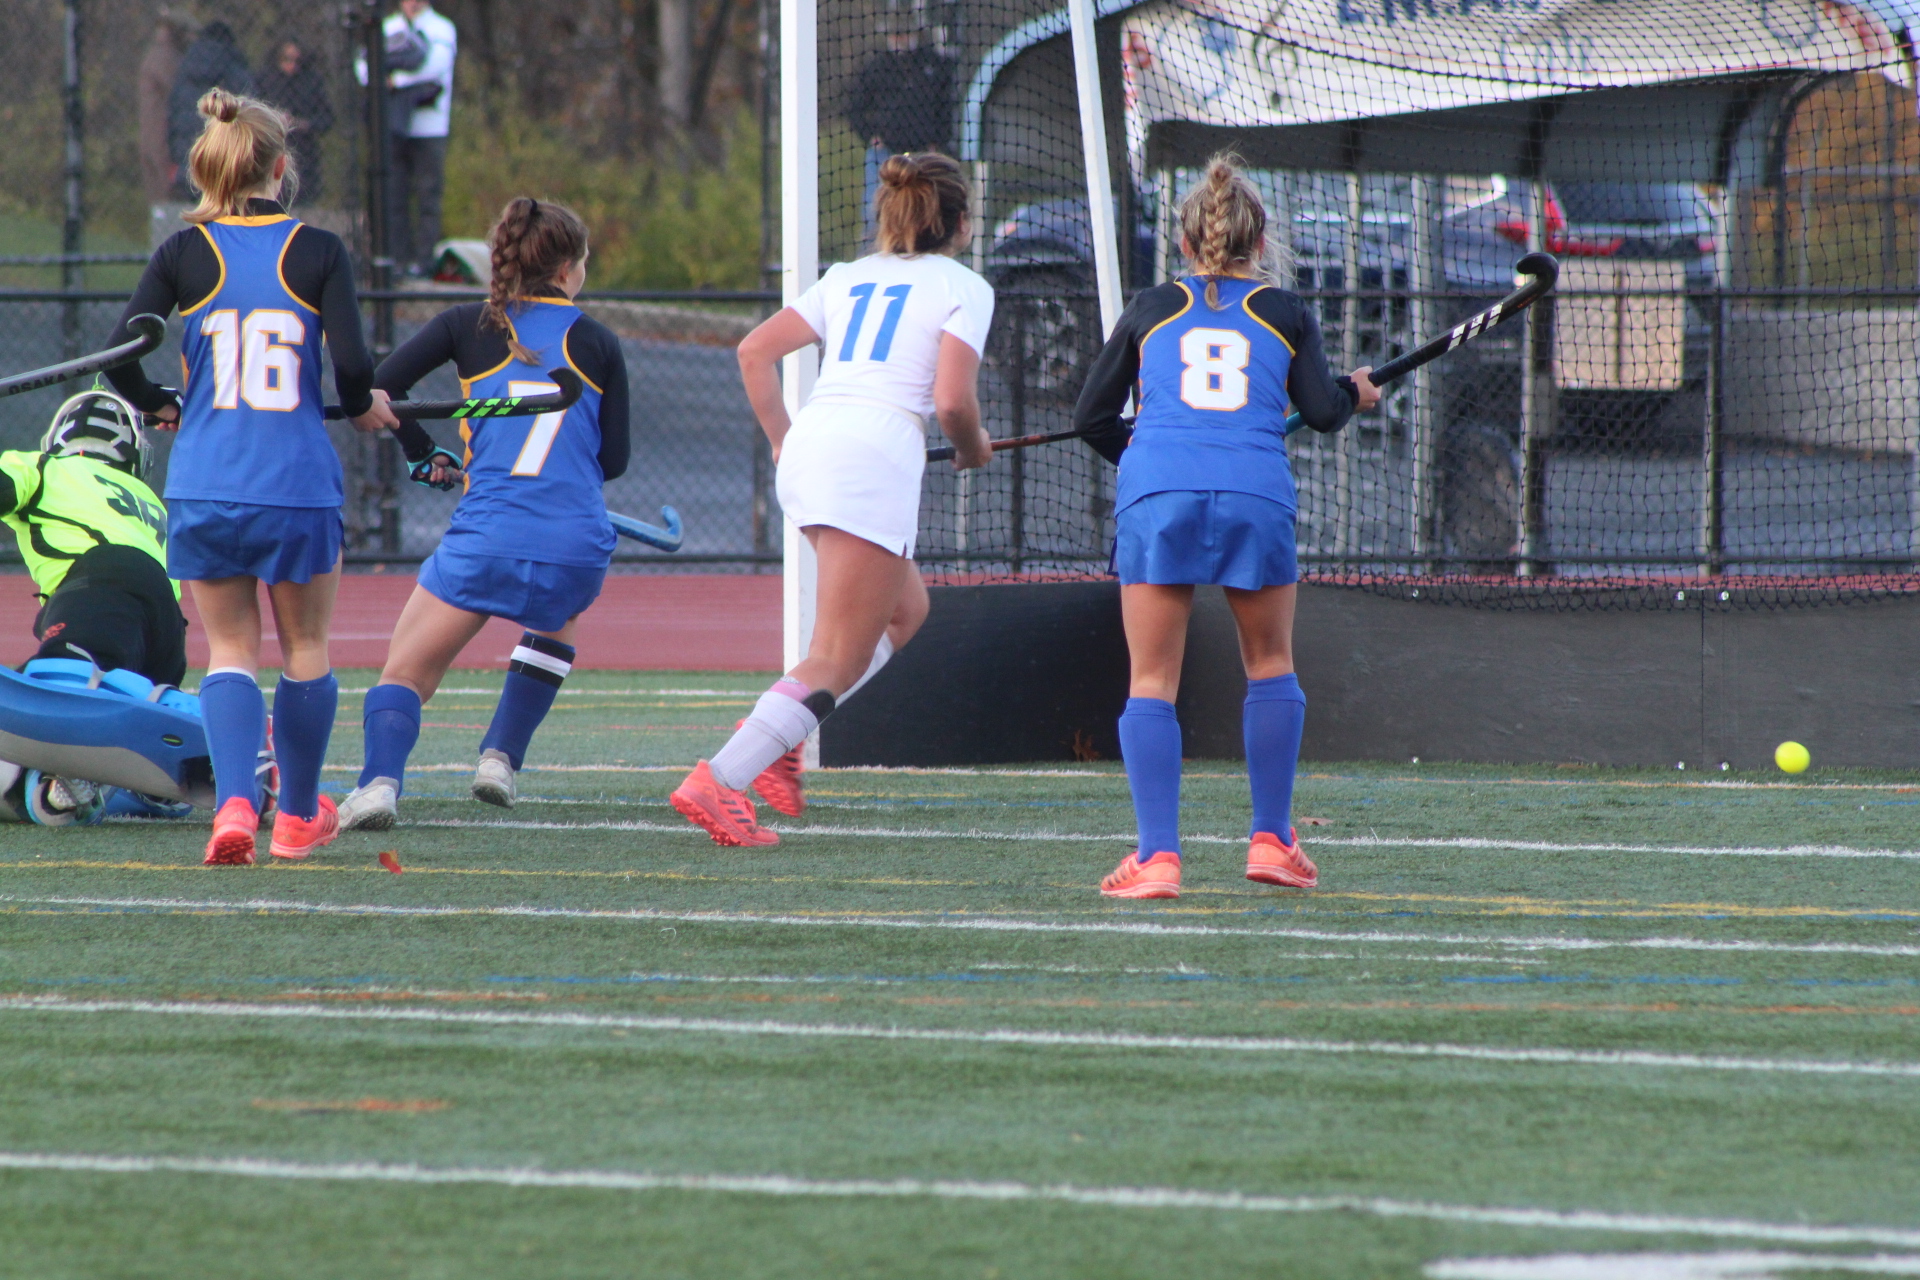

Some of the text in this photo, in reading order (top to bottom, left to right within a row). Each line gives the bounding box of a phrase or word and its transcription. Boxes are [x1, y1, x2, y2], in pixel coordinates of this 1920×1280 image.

[201, 308, 305, 412] 16
[838, 282, 913, 362] 11
[8, 372, 68, 395] OSAKA
[1180, 327, 1251, 412] 8
[508, 380, 568, 476] 7
